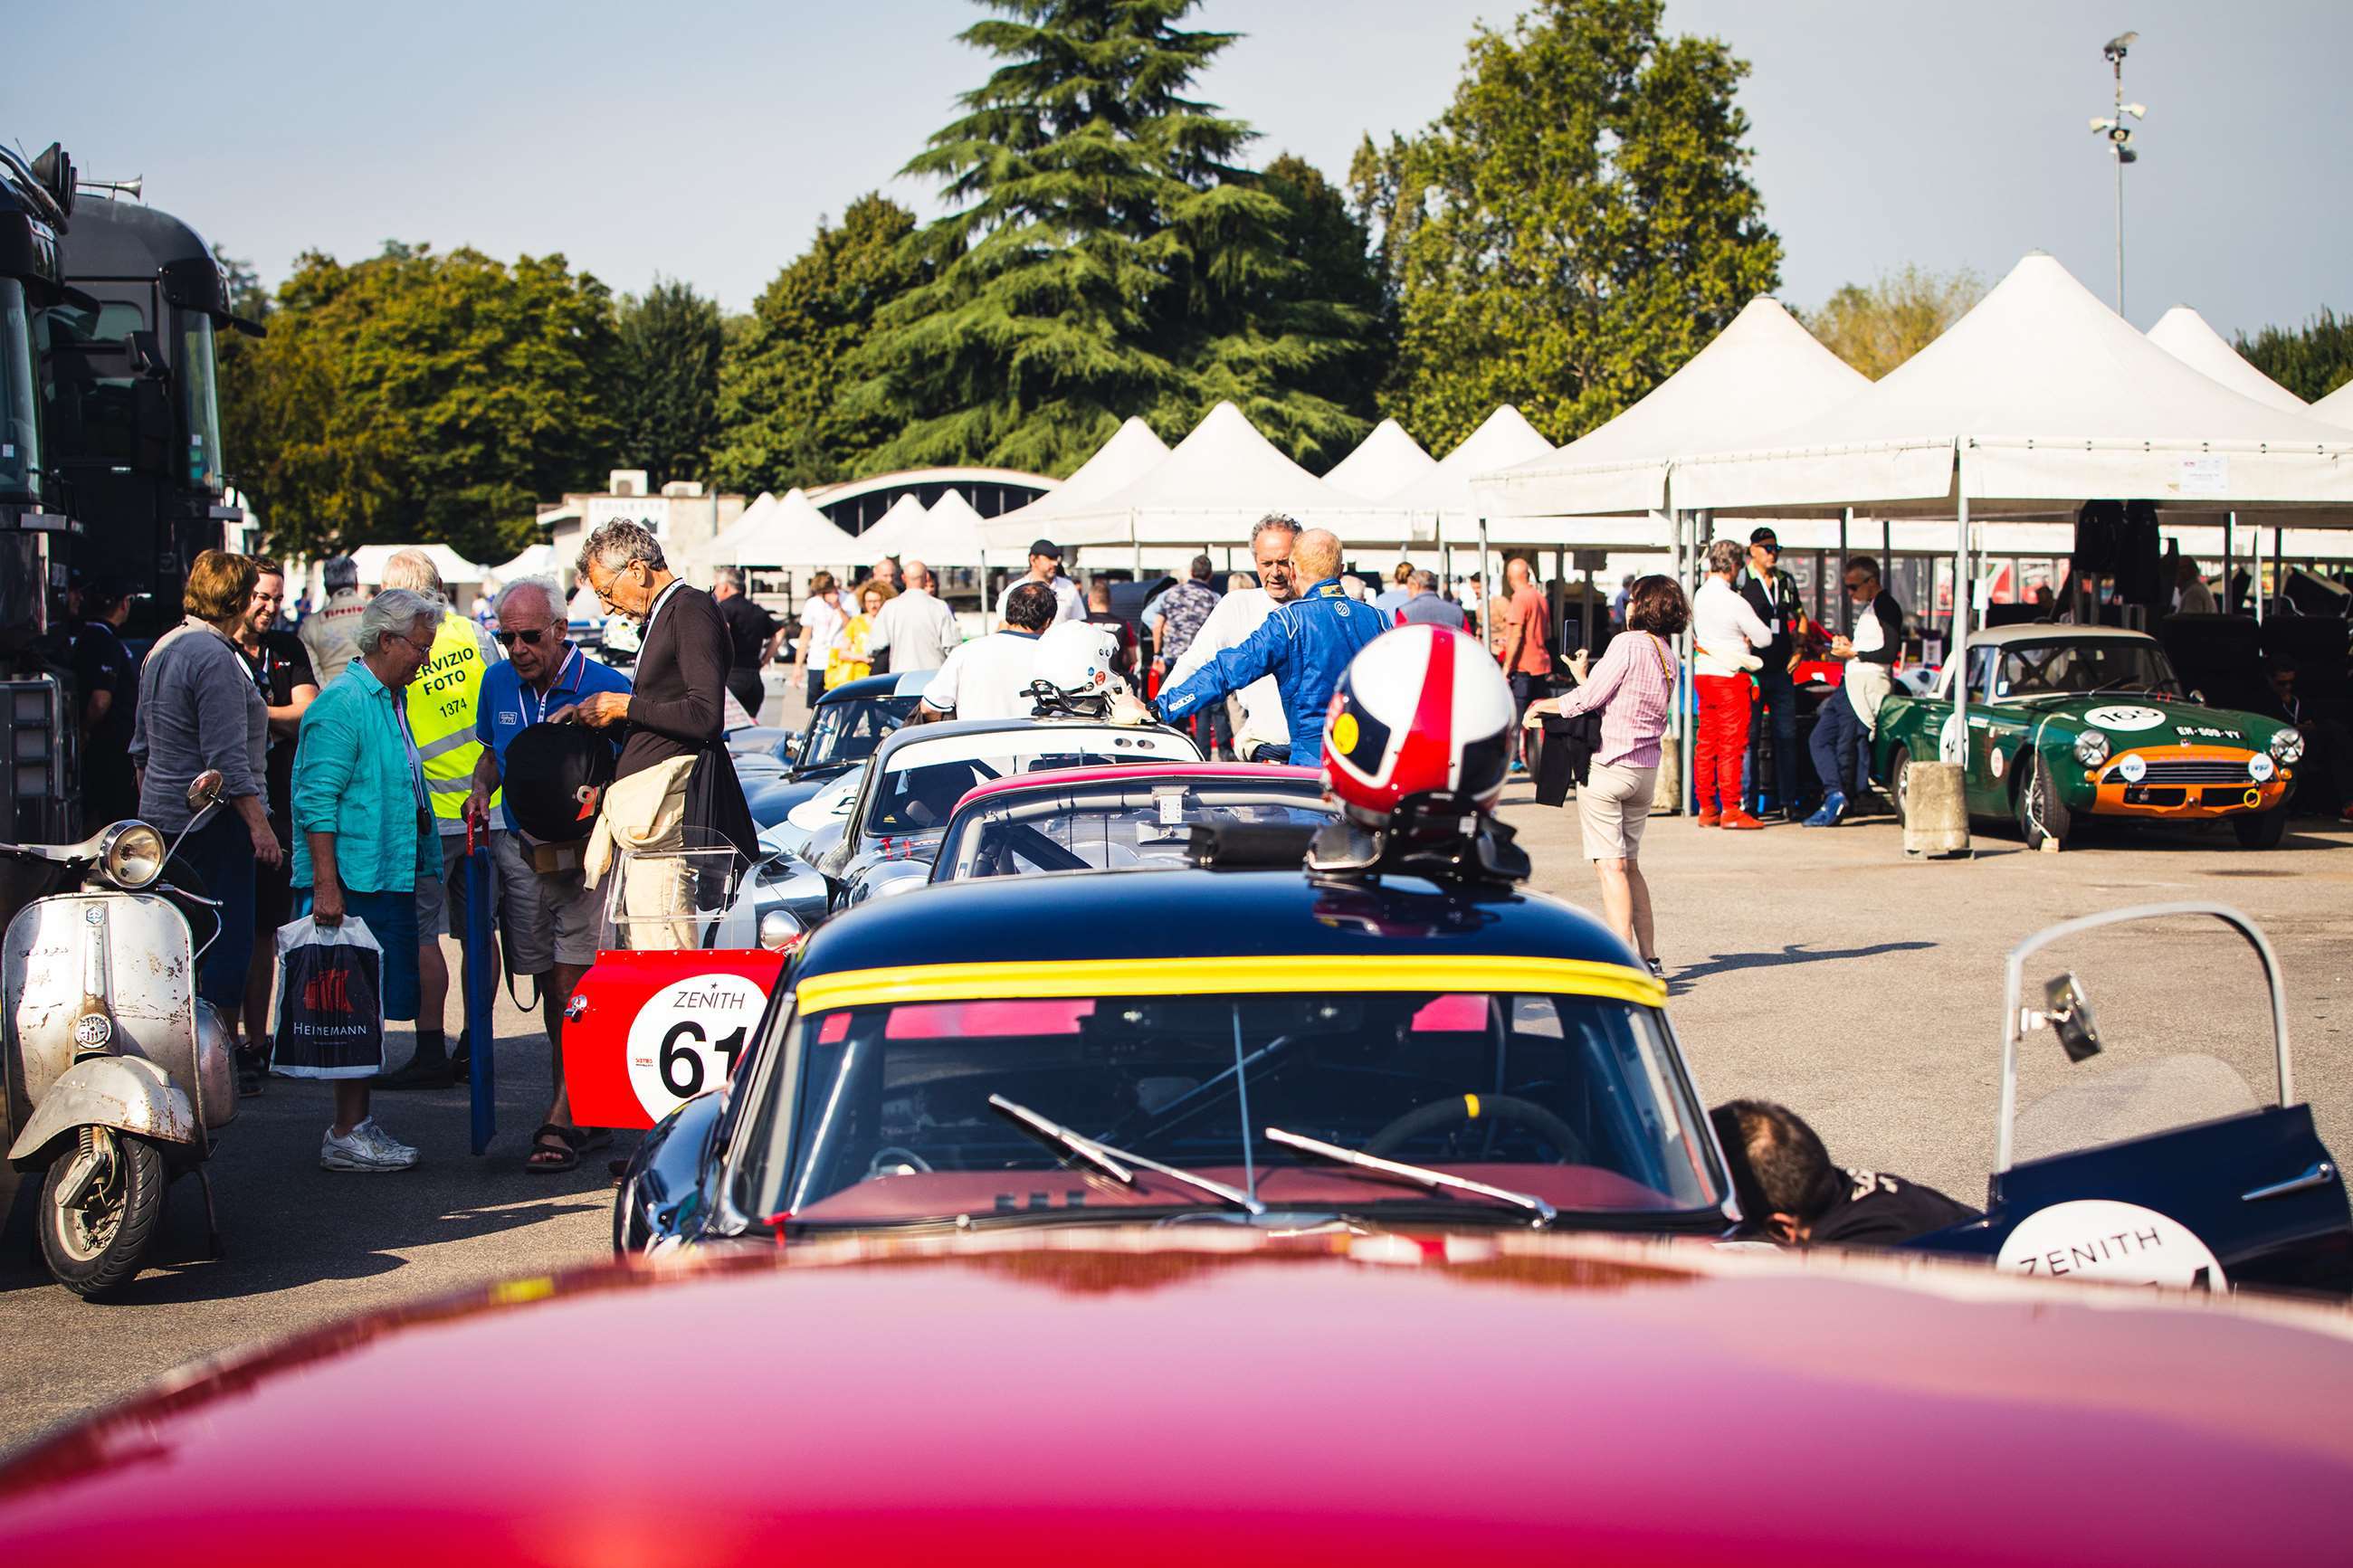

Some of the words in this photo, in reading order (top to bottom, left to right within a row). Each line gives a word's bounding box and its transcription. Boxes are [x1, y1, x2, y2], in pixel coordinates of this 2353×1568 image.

[415, 648, 474, 680] ERVIZIO
[423, 670, 466, 696] FOTO
[439, 698, 468, 717] 1374
[2098, 708, 2159, 723] 165
[672, 991, 746, 1010] ZENITH
[293, 1022, 367, 1036] HEINEMANN
[659, 1021, 748, 1099] 61
[2019, 1226, 2162, 1277] ZENITH
